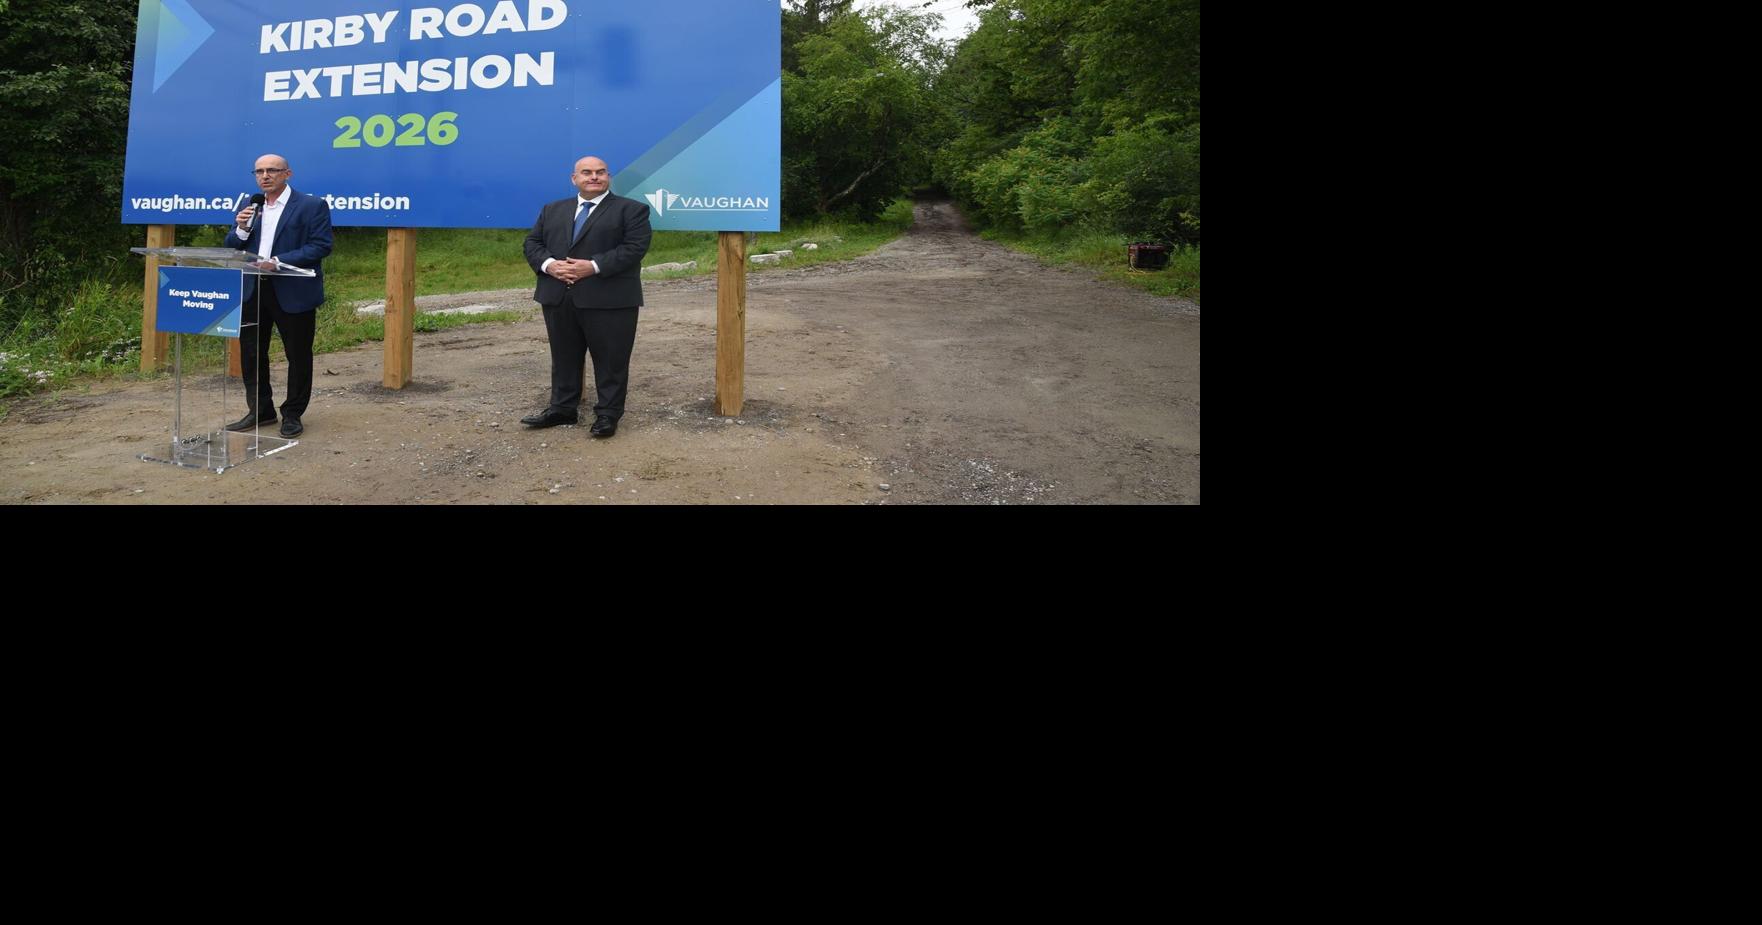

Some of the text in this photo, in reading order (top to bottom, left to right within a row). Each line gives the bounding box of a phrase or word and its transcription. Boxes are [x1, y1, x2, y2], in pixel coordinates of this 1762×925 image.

[259, 0, 568, 54] KIRBY ROAD
[262, 51, 556, 102] EXTENSION
[332, 111, 459, 149] 2026
[680, 196, 769, 209] VAUGHAN
[168, 288, 230, 300] Keep Vaughan
[182, 299, 214, 311] Moving
